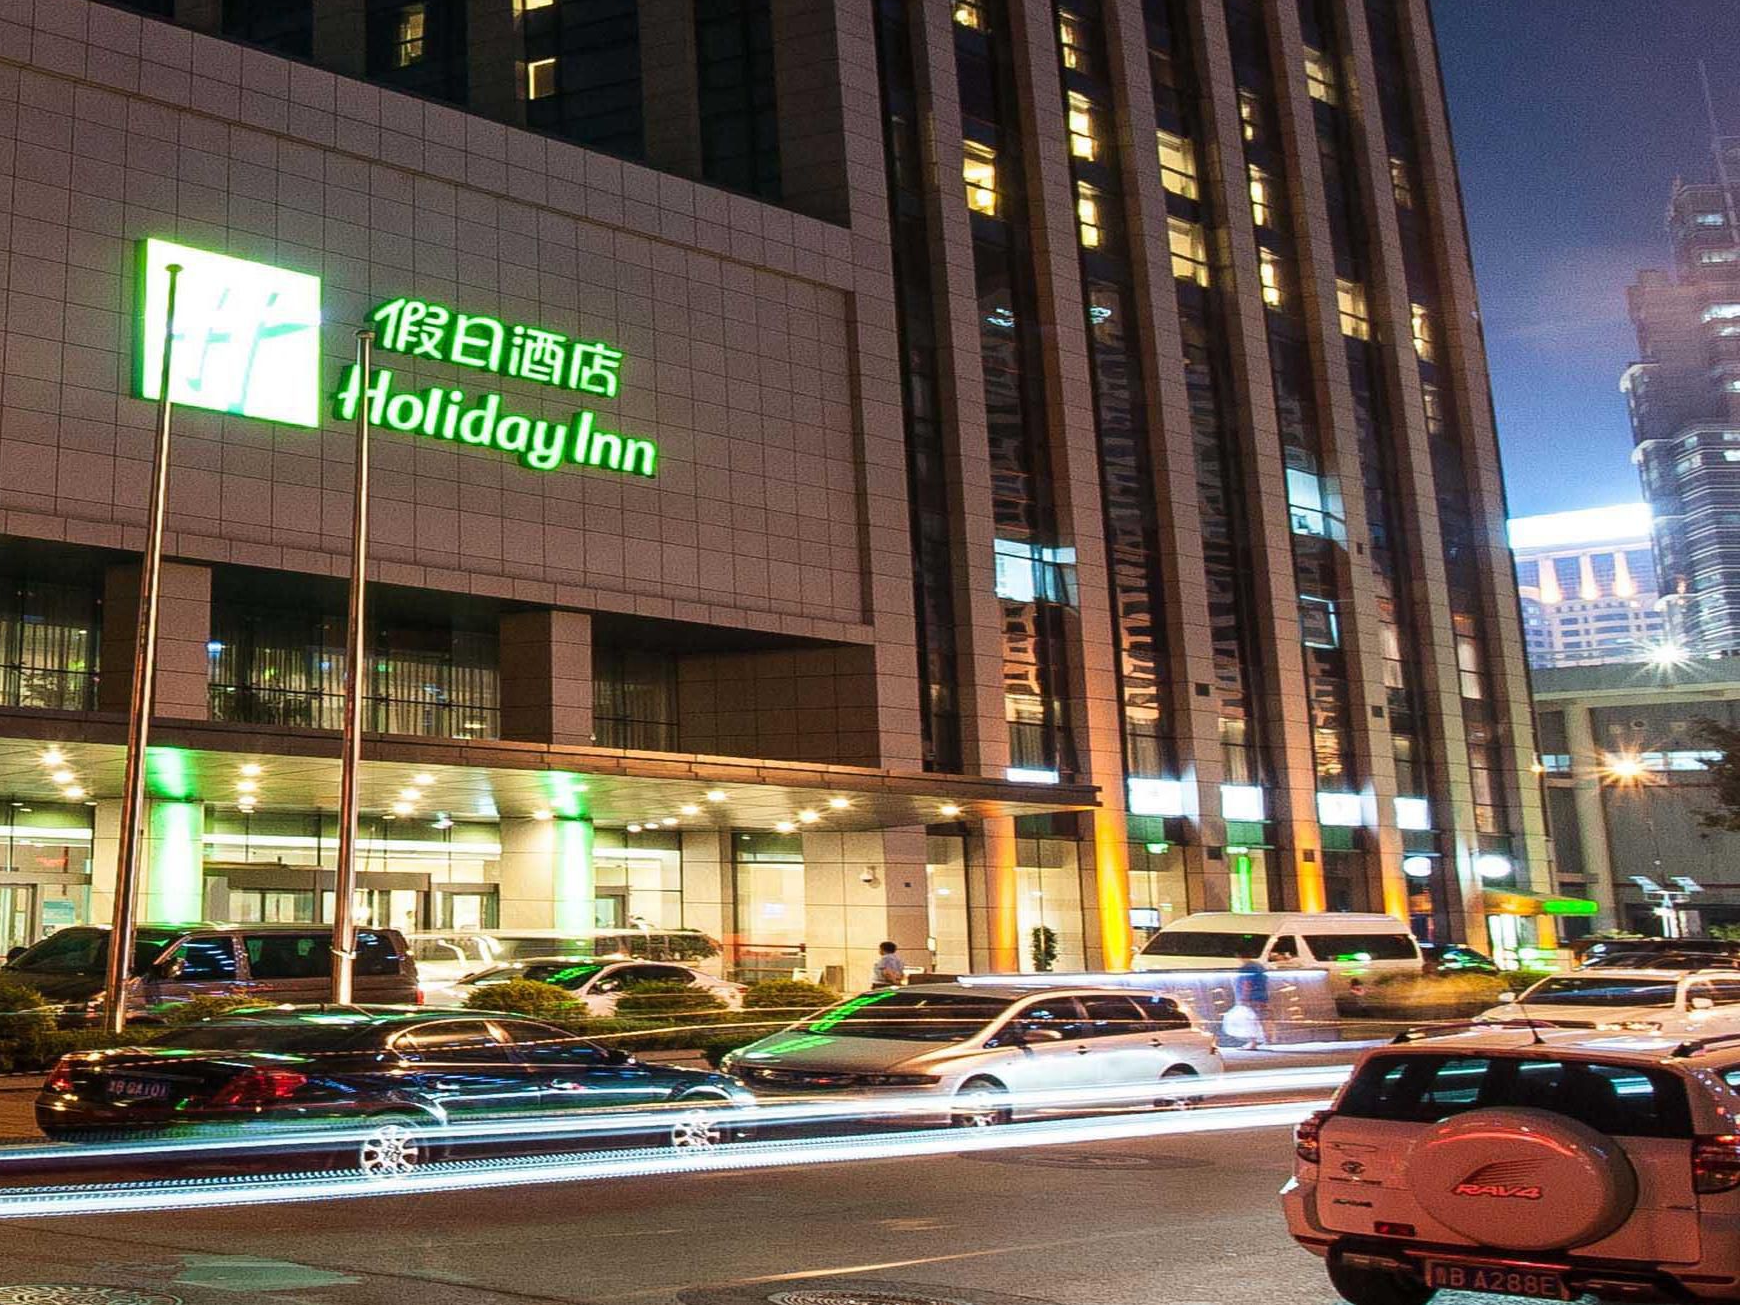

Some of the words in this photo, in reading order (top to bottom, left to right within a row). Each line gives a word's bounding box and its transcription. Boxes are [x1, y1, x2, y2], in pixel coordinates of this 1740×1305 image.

[370, 297, 622, 397] 假日酒店
[337, 362, 567, 471] Holiday
[573, 409, 656, 477] Inn
[1454, 1183, 1542, 1199] RAV4
